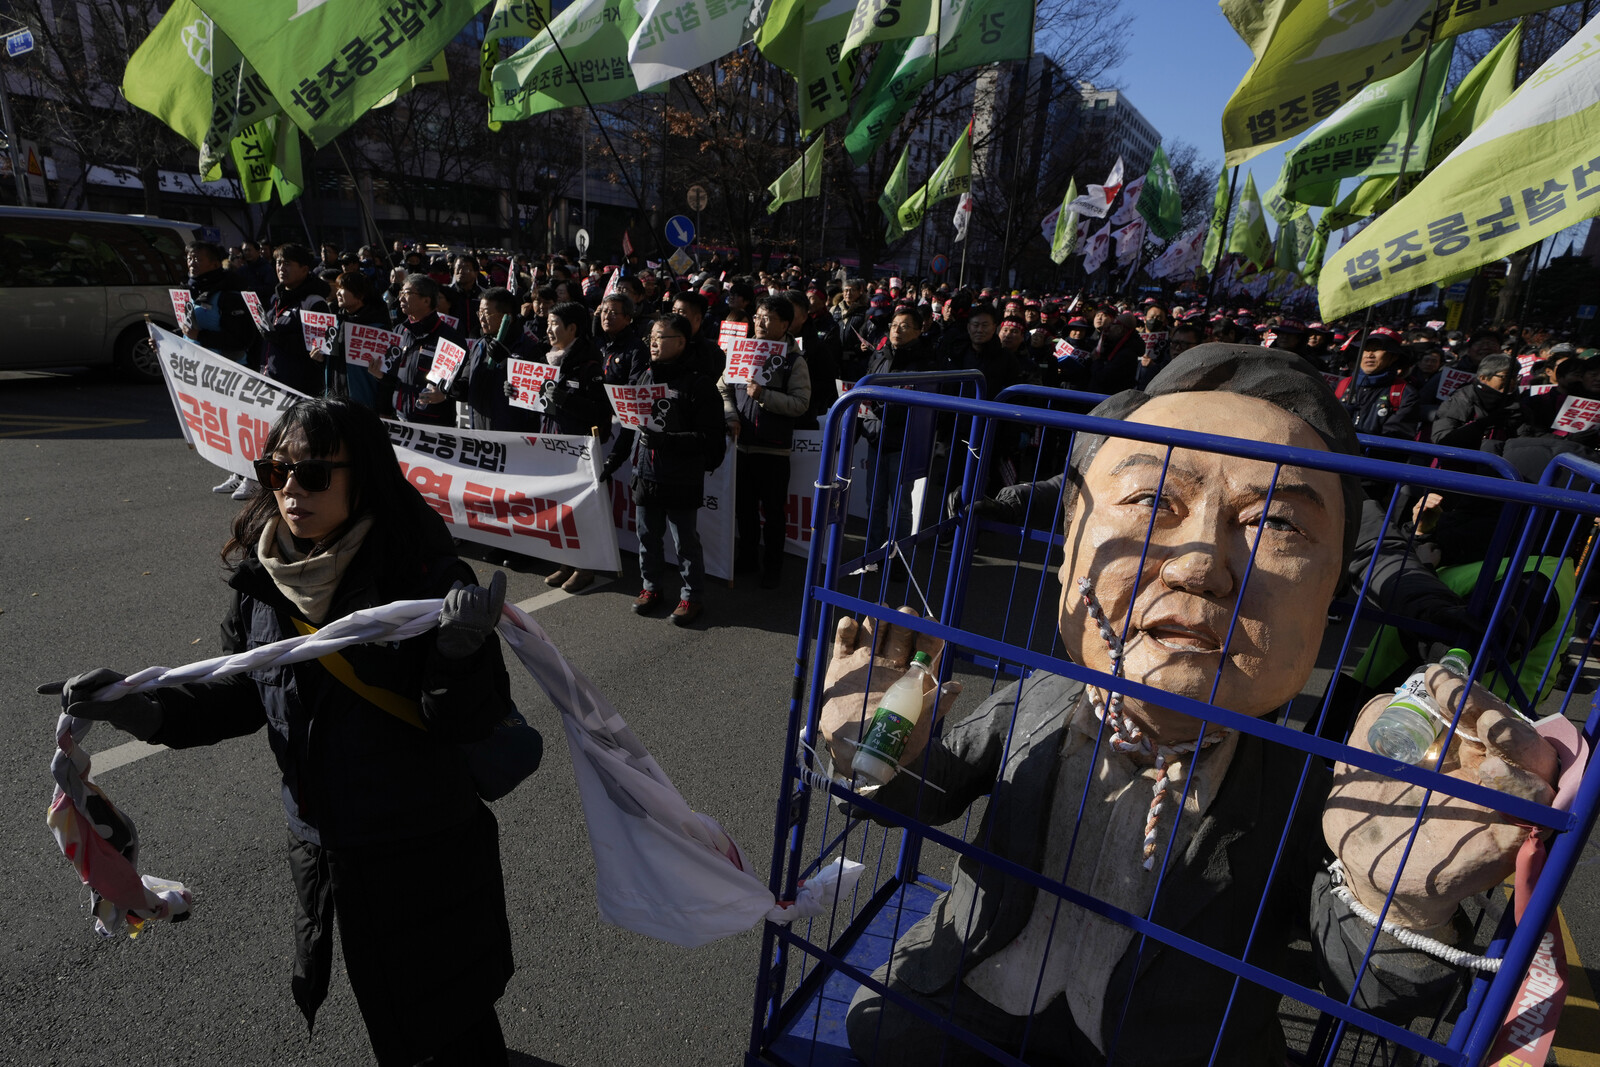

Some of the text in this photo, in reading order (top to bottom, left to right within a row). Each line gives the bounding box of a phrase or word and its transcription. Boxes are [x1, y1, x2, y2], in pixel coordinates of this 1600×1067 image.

[304, 312, 335, 327] 내란수괴
[305, 324, 326, 337] 윤석열
[351, 325, 401, 346] 내란수괴
[349, 338, 388, 355] 윤석열
[440, 341, 464, 363] 내란수괴
[733, 340, 784, 356] 내란수괴
[730, 353, 767, 366] 윤석열
[512, 361, 557, 381] 내란수괴
[728, 366, 759, 379] 구속!
[170, 352, 200, 386] 헌법
[202, 364, 242, 397] 파괴!
[239, 377, 281, 408] 민주
[511, 375, 542, 392] 윤석열
[611, 386, 665, 400] 내란수괴
[615, 401, 653, 415] 윤석열
[178, 391, 232, 455] 국힘
[619, 413, 649, 428] 구속!
[414, 430, 457, 459] 노동
[459, 436, 507, 472] 탄압!
[541, 437, 591, 461] 민주노총
[463, 481, 581, 549] 탄핵!
[872, 721, 926, 745] 장수
